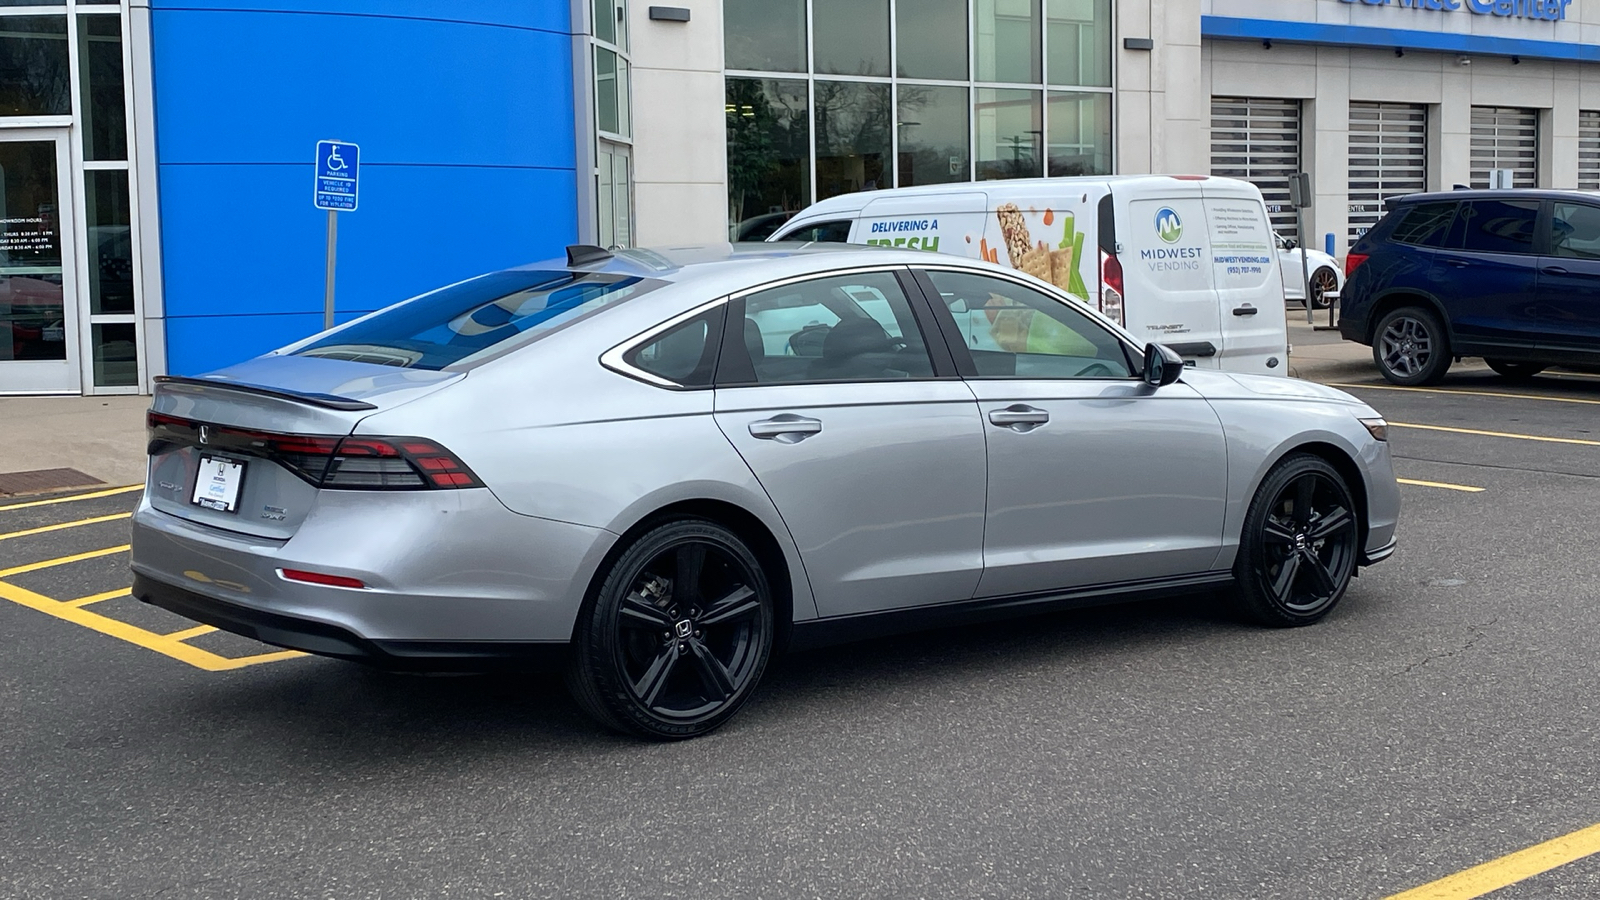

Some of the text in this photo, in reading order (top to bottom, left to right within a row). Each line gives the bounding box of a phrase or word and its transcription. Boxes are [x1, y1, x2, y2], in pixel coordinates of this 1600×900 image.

[1466, 0, 1572, 20] Center
[871, 219, 938, 233] DELIVERING A
[867, 236, 940, 252] ESH
[1140, 247, 1202, 260] MIDWEST
[1213, 256, 1270, 264] MIDWESTVENDING.COM
[1147, 260, 1199, 272] VENDING
[1146, 323, 1184, 331] TRANSIT
